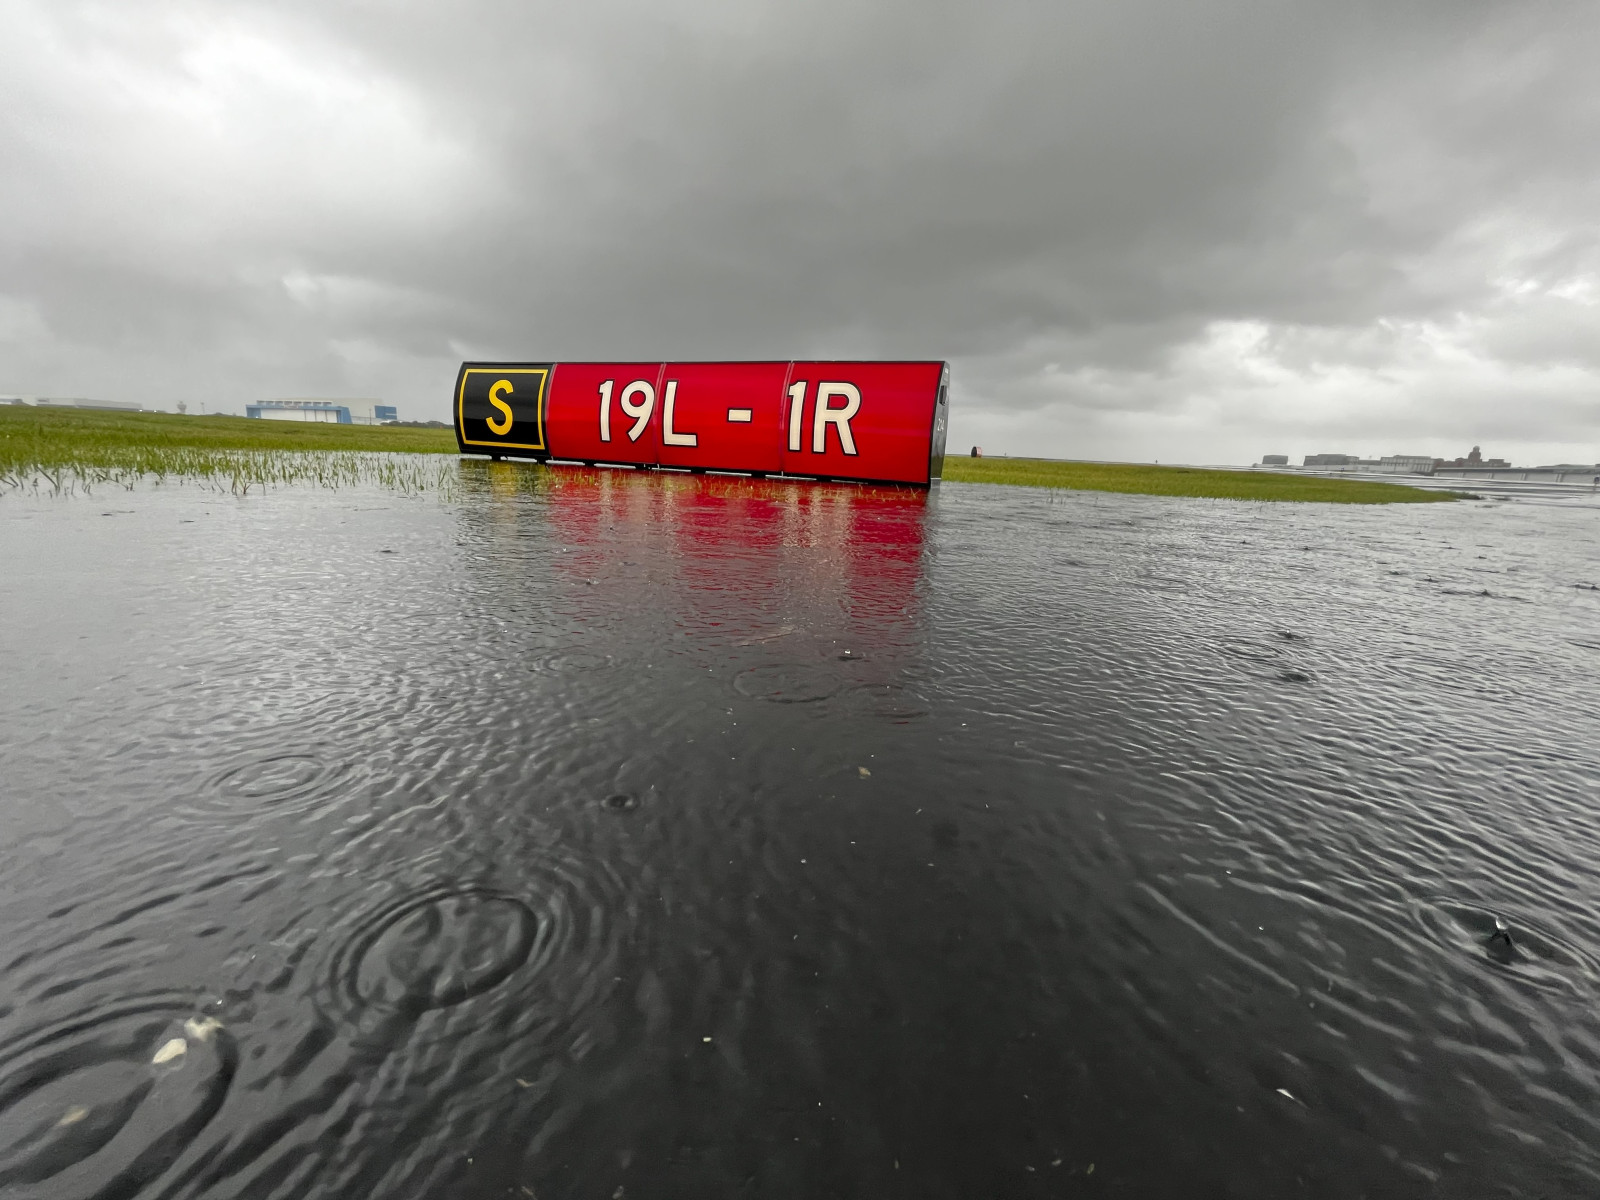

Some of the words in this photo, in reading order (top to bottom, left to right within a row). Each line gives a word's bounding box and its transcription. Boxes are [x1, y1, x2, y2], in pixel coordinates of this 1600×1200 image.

[485, 379, 514, 436] S
[598, 379, 698, 447] 19L
[727, 408, 753, 423] -
[787, 380, 862, 455] 1R
